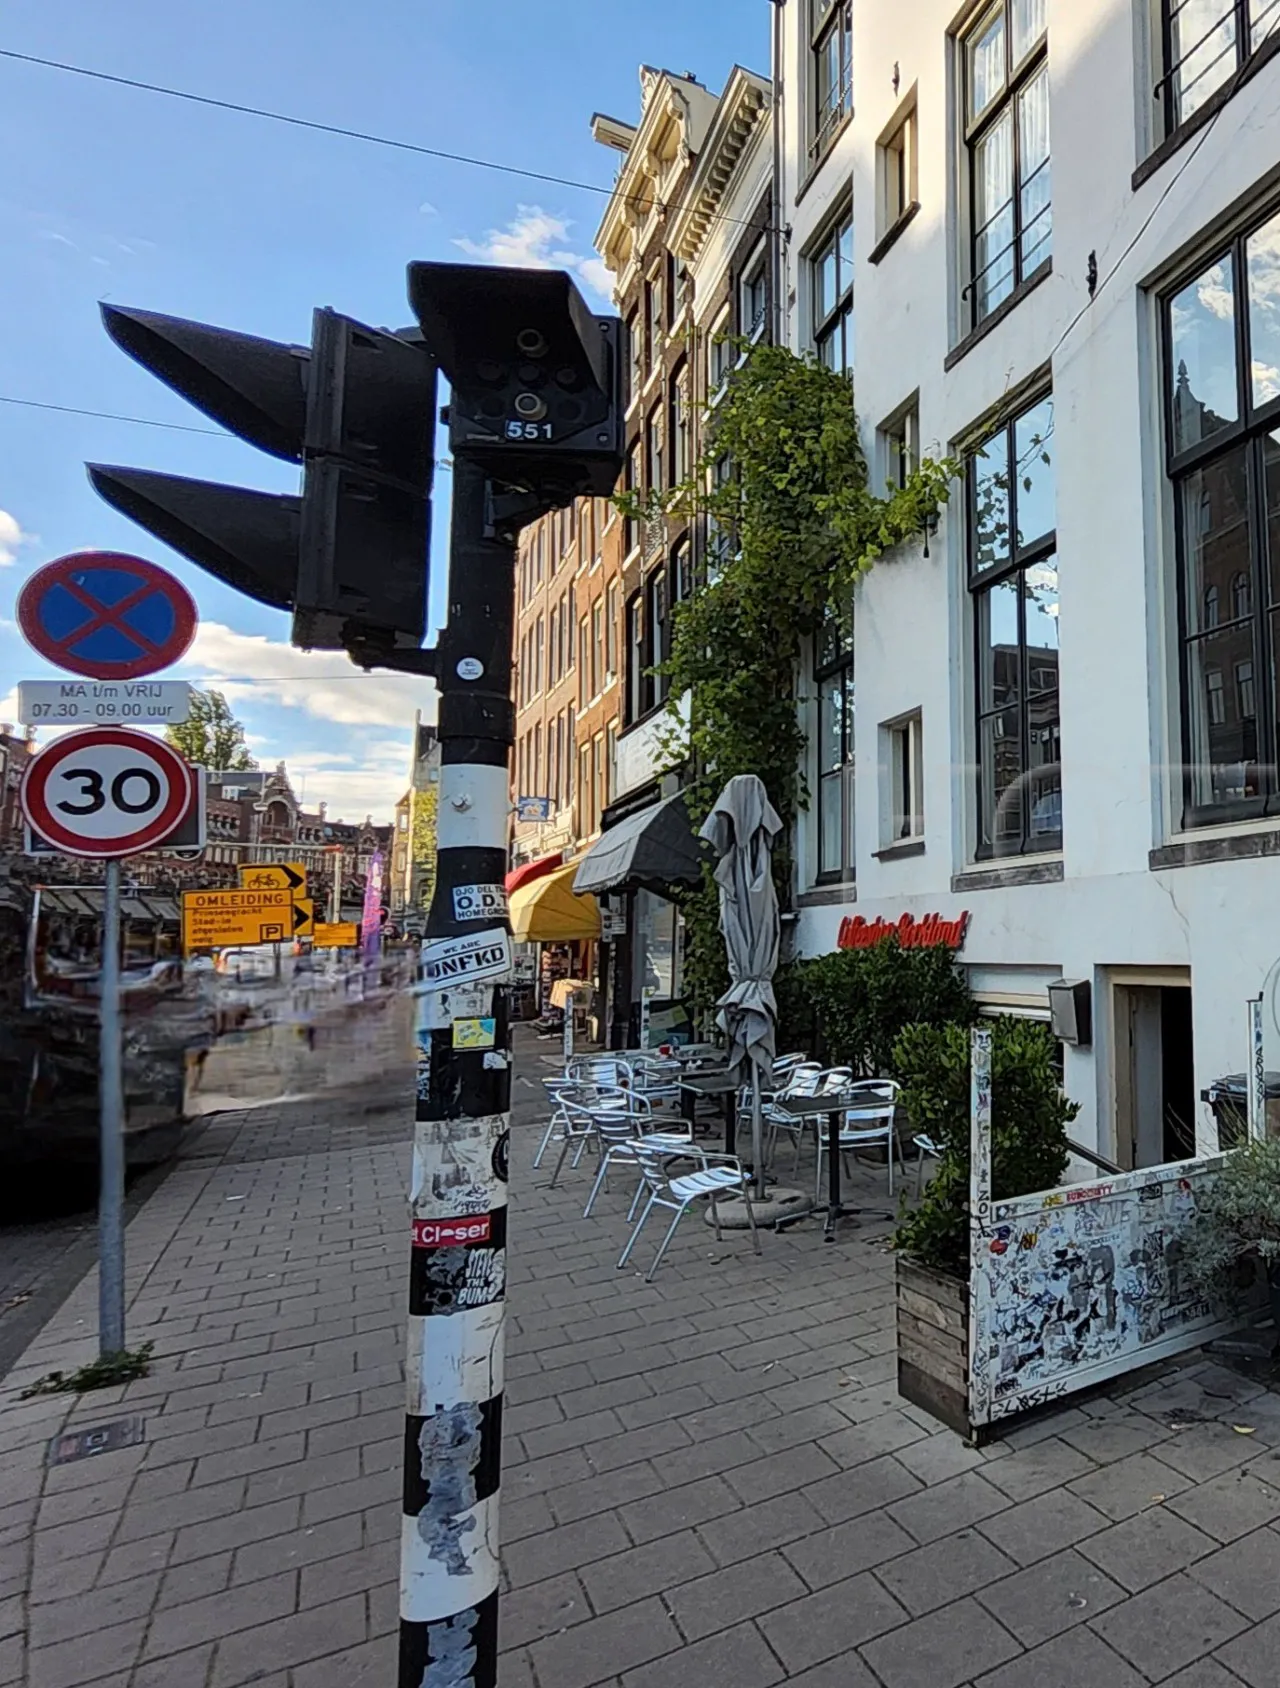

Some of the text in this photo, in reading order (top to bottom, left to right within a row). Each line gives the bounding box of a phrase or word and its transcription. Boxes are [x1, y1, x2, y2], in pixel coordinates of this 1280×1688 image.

[507, 421, 553, 439] 551
[60, 684, 163, 698] MA t/m VRIJ
[32, 703, 79, 717] 07.30
[96, 703, 142, 717] 09.00
[147, 705, 175, 717] uur
[56, 767, 161, 816] 30
[195, 893, 284, 907] OMLEIDING
[442, 940, 481, 955] WE ARE
